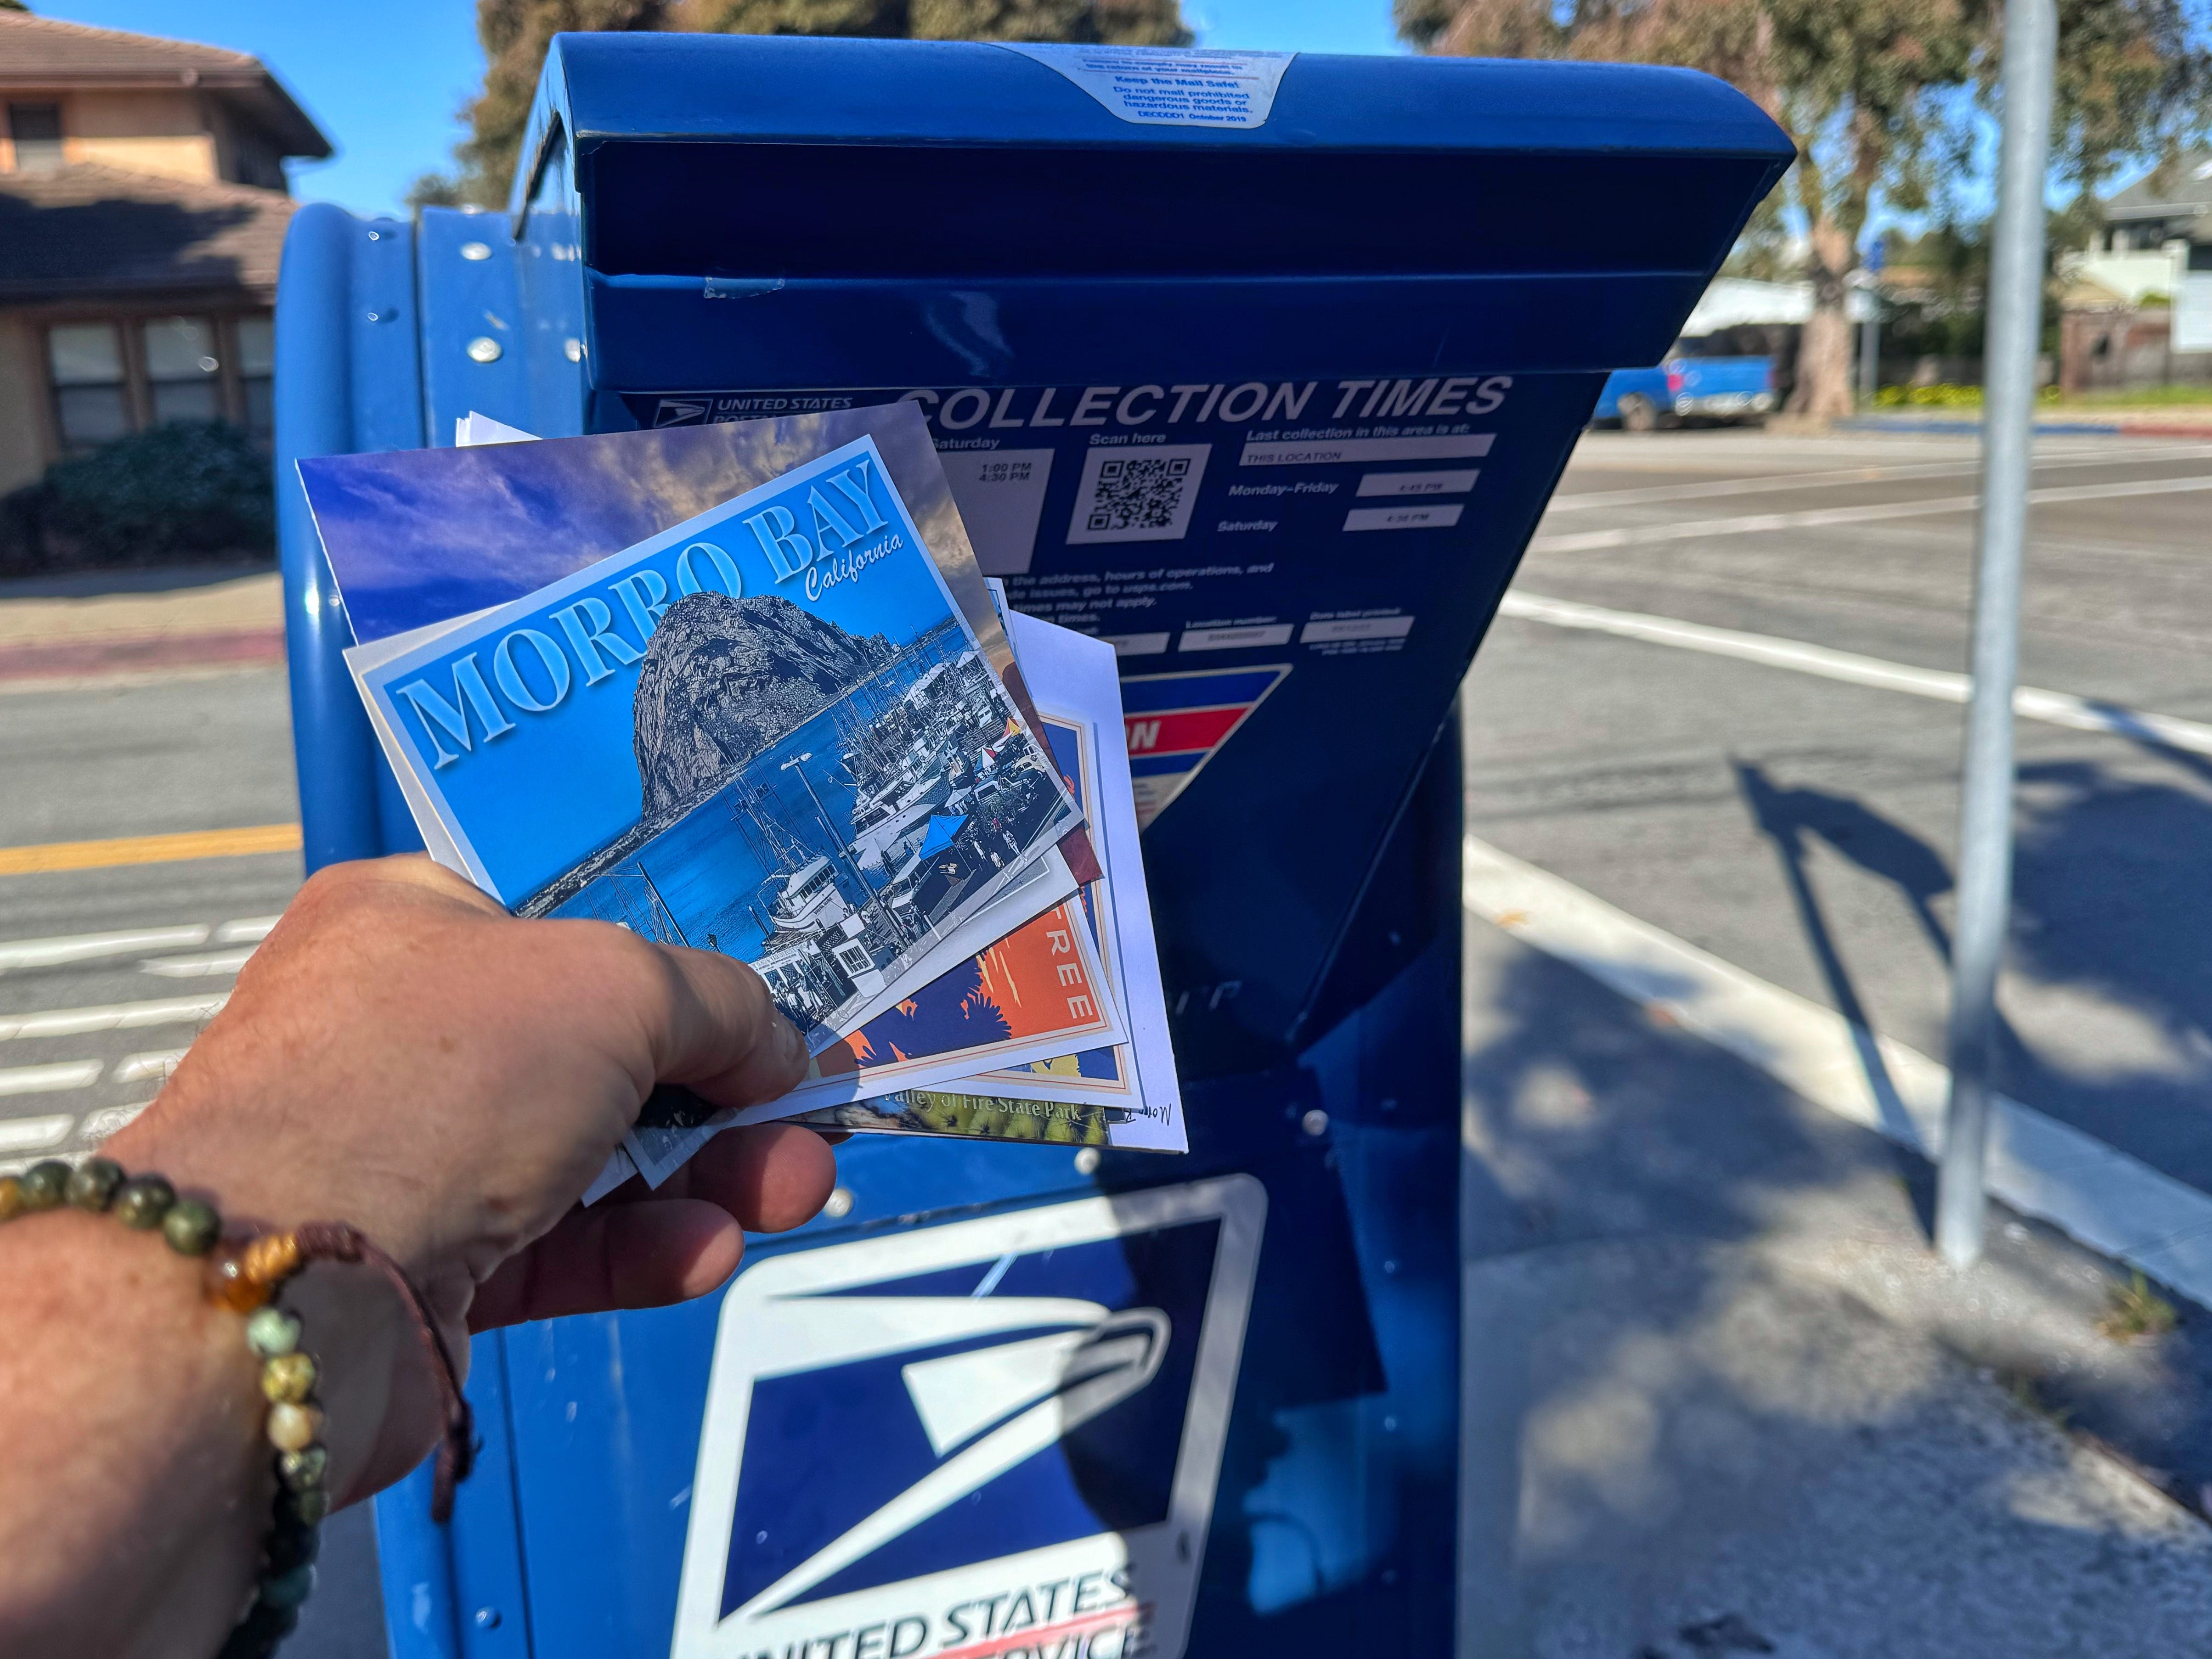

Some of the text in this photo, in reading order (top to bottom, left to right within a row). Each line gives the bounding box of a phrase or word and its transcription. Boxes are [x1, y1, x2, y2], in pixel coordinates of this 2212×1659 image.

[1115, 76, 1148, 84] Keep
[1123, 94, 1190, 103] dangerous
[1188, 90, 1250, 99] prohibited
[1124, 101, 1253, 113] hazardous materials.
[718, 397, 853, 411] UNITED STATES
[1332, 376, 1513, 419] TIMES
[1089, 433, 1166, 446] Scan here
[1246, 424, 1470, 442] Last collection in this area is at:
[933, 437, 1000, 450] Saturday
[1247, 452, 1342, 463] THIS LOCATION
[982, 463, 1032, 473] 1:00 PM
[979, 472, 1030, 482] 4:30 PM
[1217, 520, 1278, 533] Saturday
[804, 533, 903, 602] California
[1013, 577, 1036, 586] the
[1039, 574, 1100, 586] address,
[1104, 571, 1146, 581] hours
[1148, 568, 1165, 579] of
[1166, 566, 1243, 579] operations,
[1246, 562, 1275, 574] and
[1083, 587, 1102, 598] go
[1105, 584, 1120, 595] to
[1055, 601, 1088, 613] may
[1089, 599, 1113, 609] not
[1116, 596, 1157, 608] apply.
[396, 460, 889, 770] MORRO BAY
[963, 1095, 994, 1111] Fire
[998, 1098, 1040, 1116] State
[1045, 1101, 1082, 1120] Park
[940, 1566, 1134, 1646] STATES
